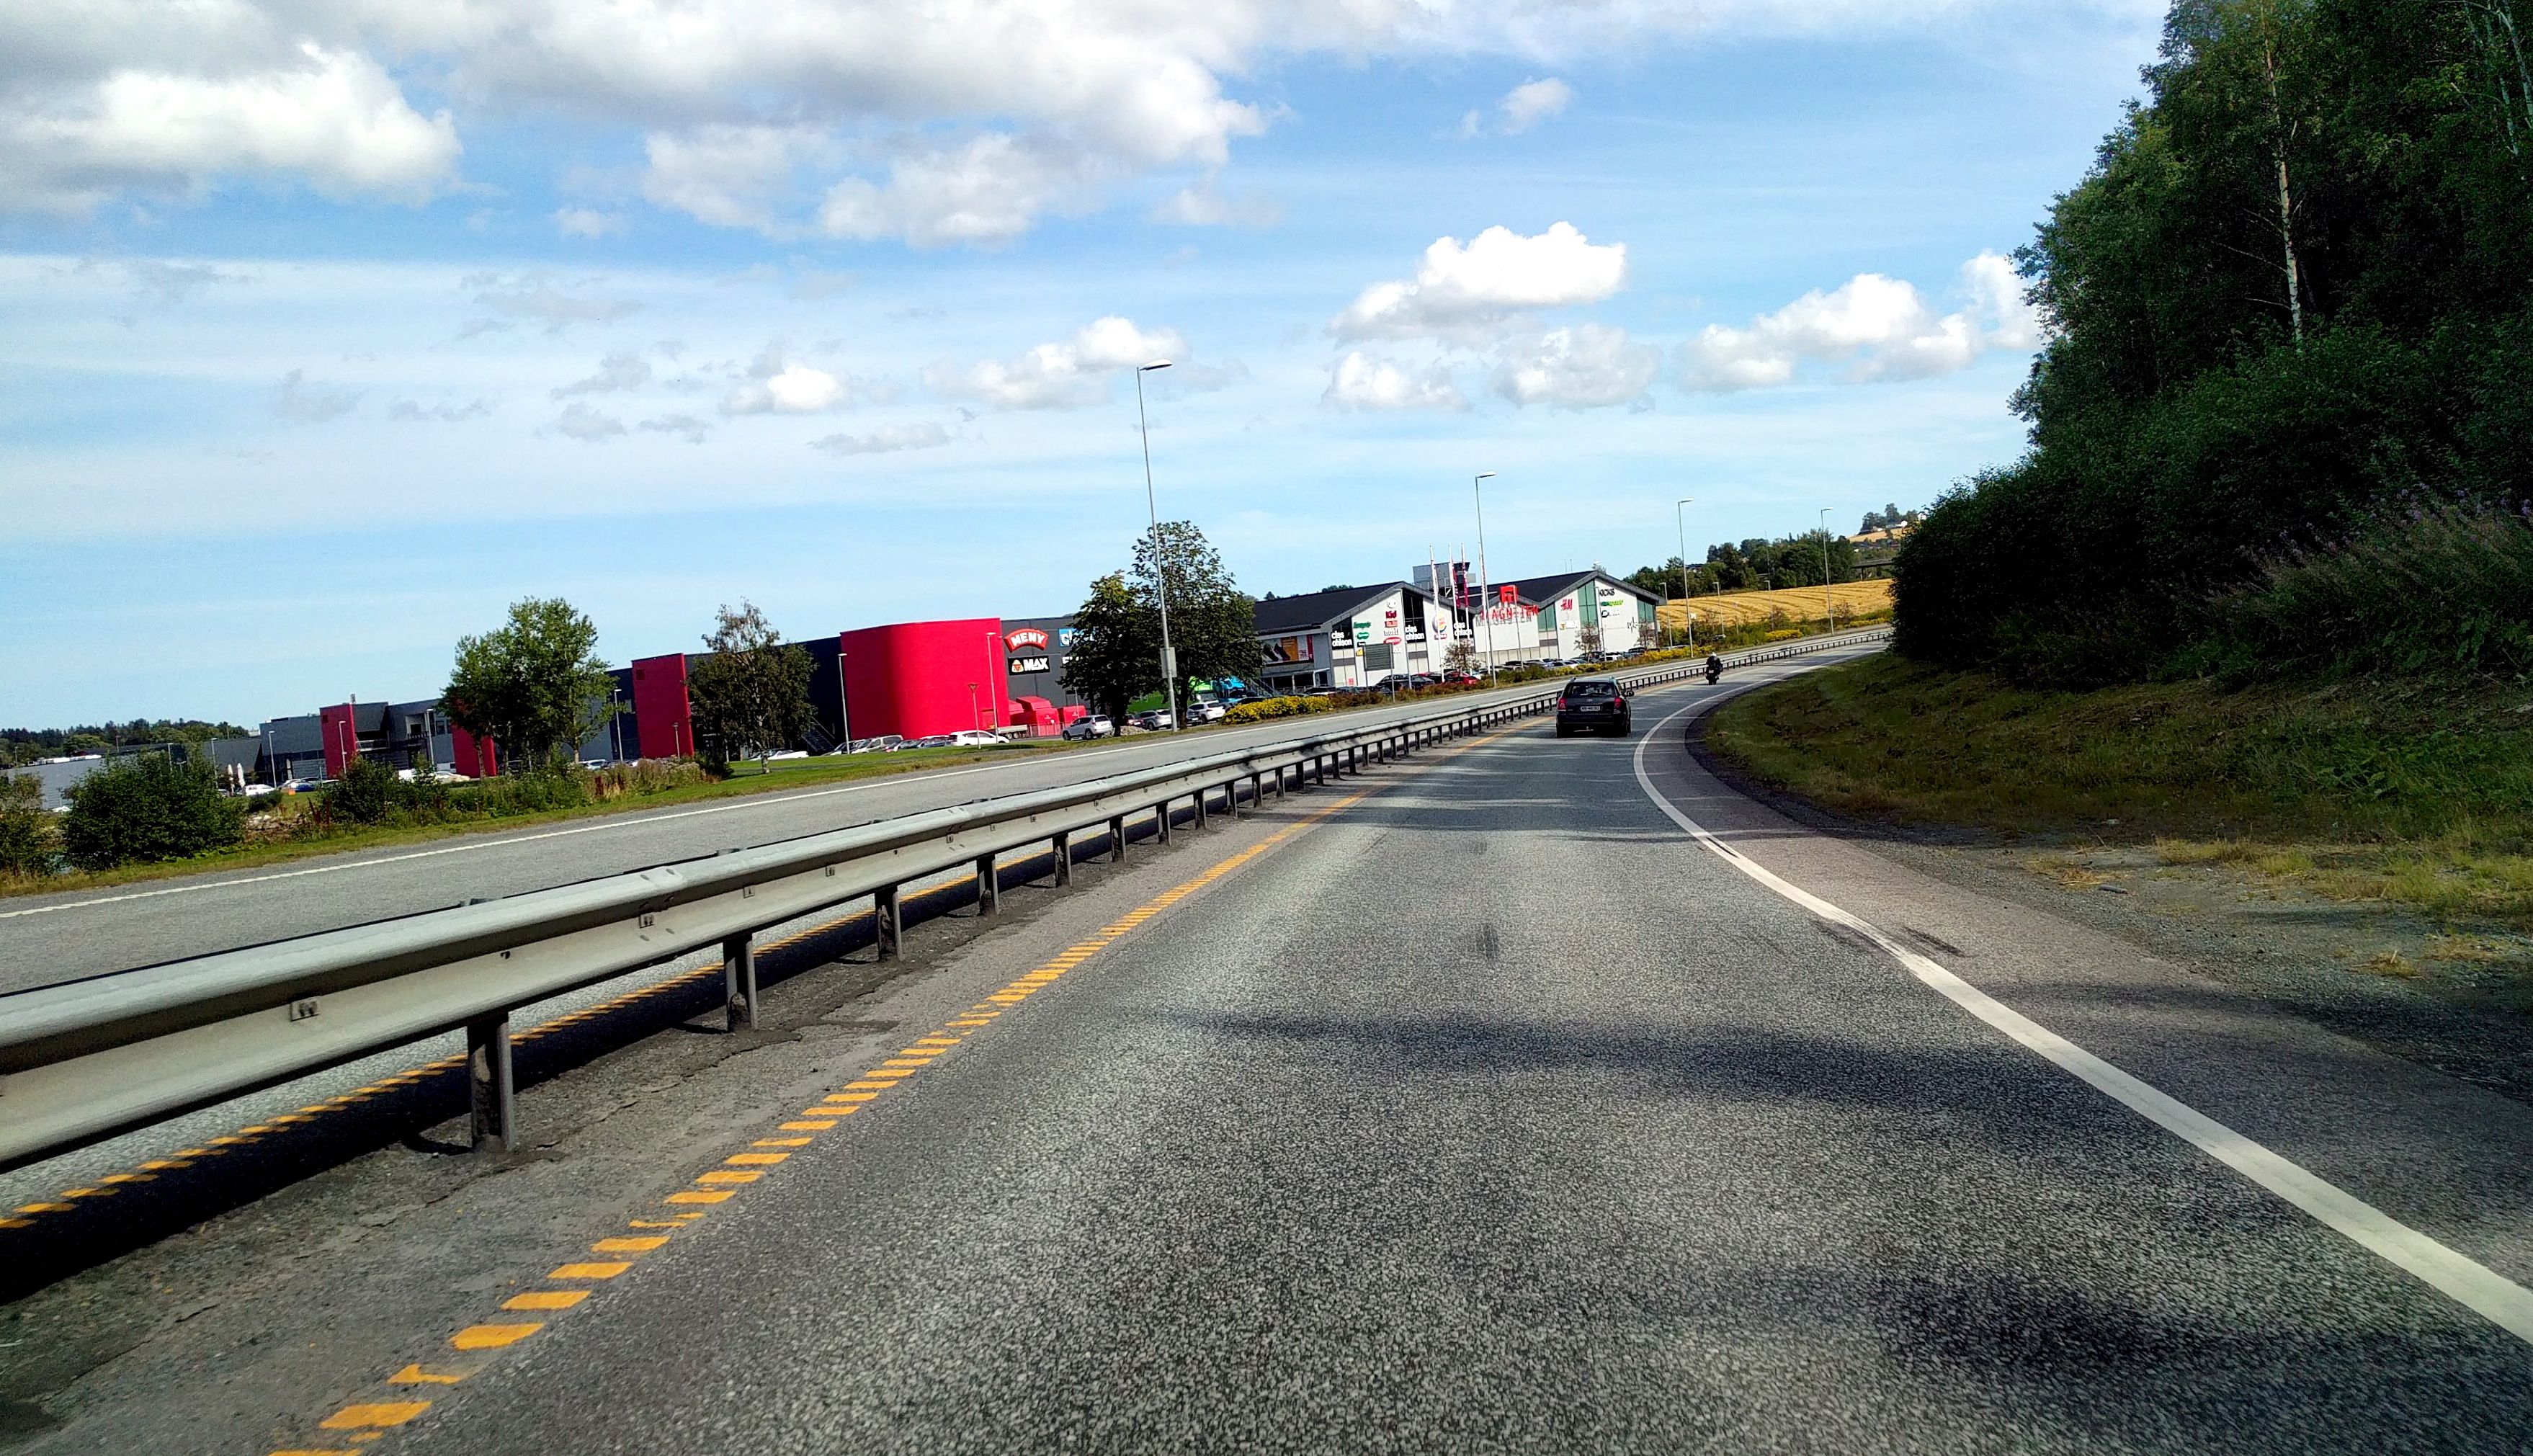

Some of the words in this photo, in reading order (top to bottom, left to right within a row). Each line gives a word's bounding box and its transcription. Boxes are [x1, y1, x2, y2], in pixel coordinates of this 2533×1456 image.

[1010, 632, 1045, 646] MENY
[1331, 630, 1344, 639] clas
[1406, 632, 1425, 640] ohlson
[1332, 638, 1352, 647] ohlson
[1023, 657, 1049, 671] MAX
